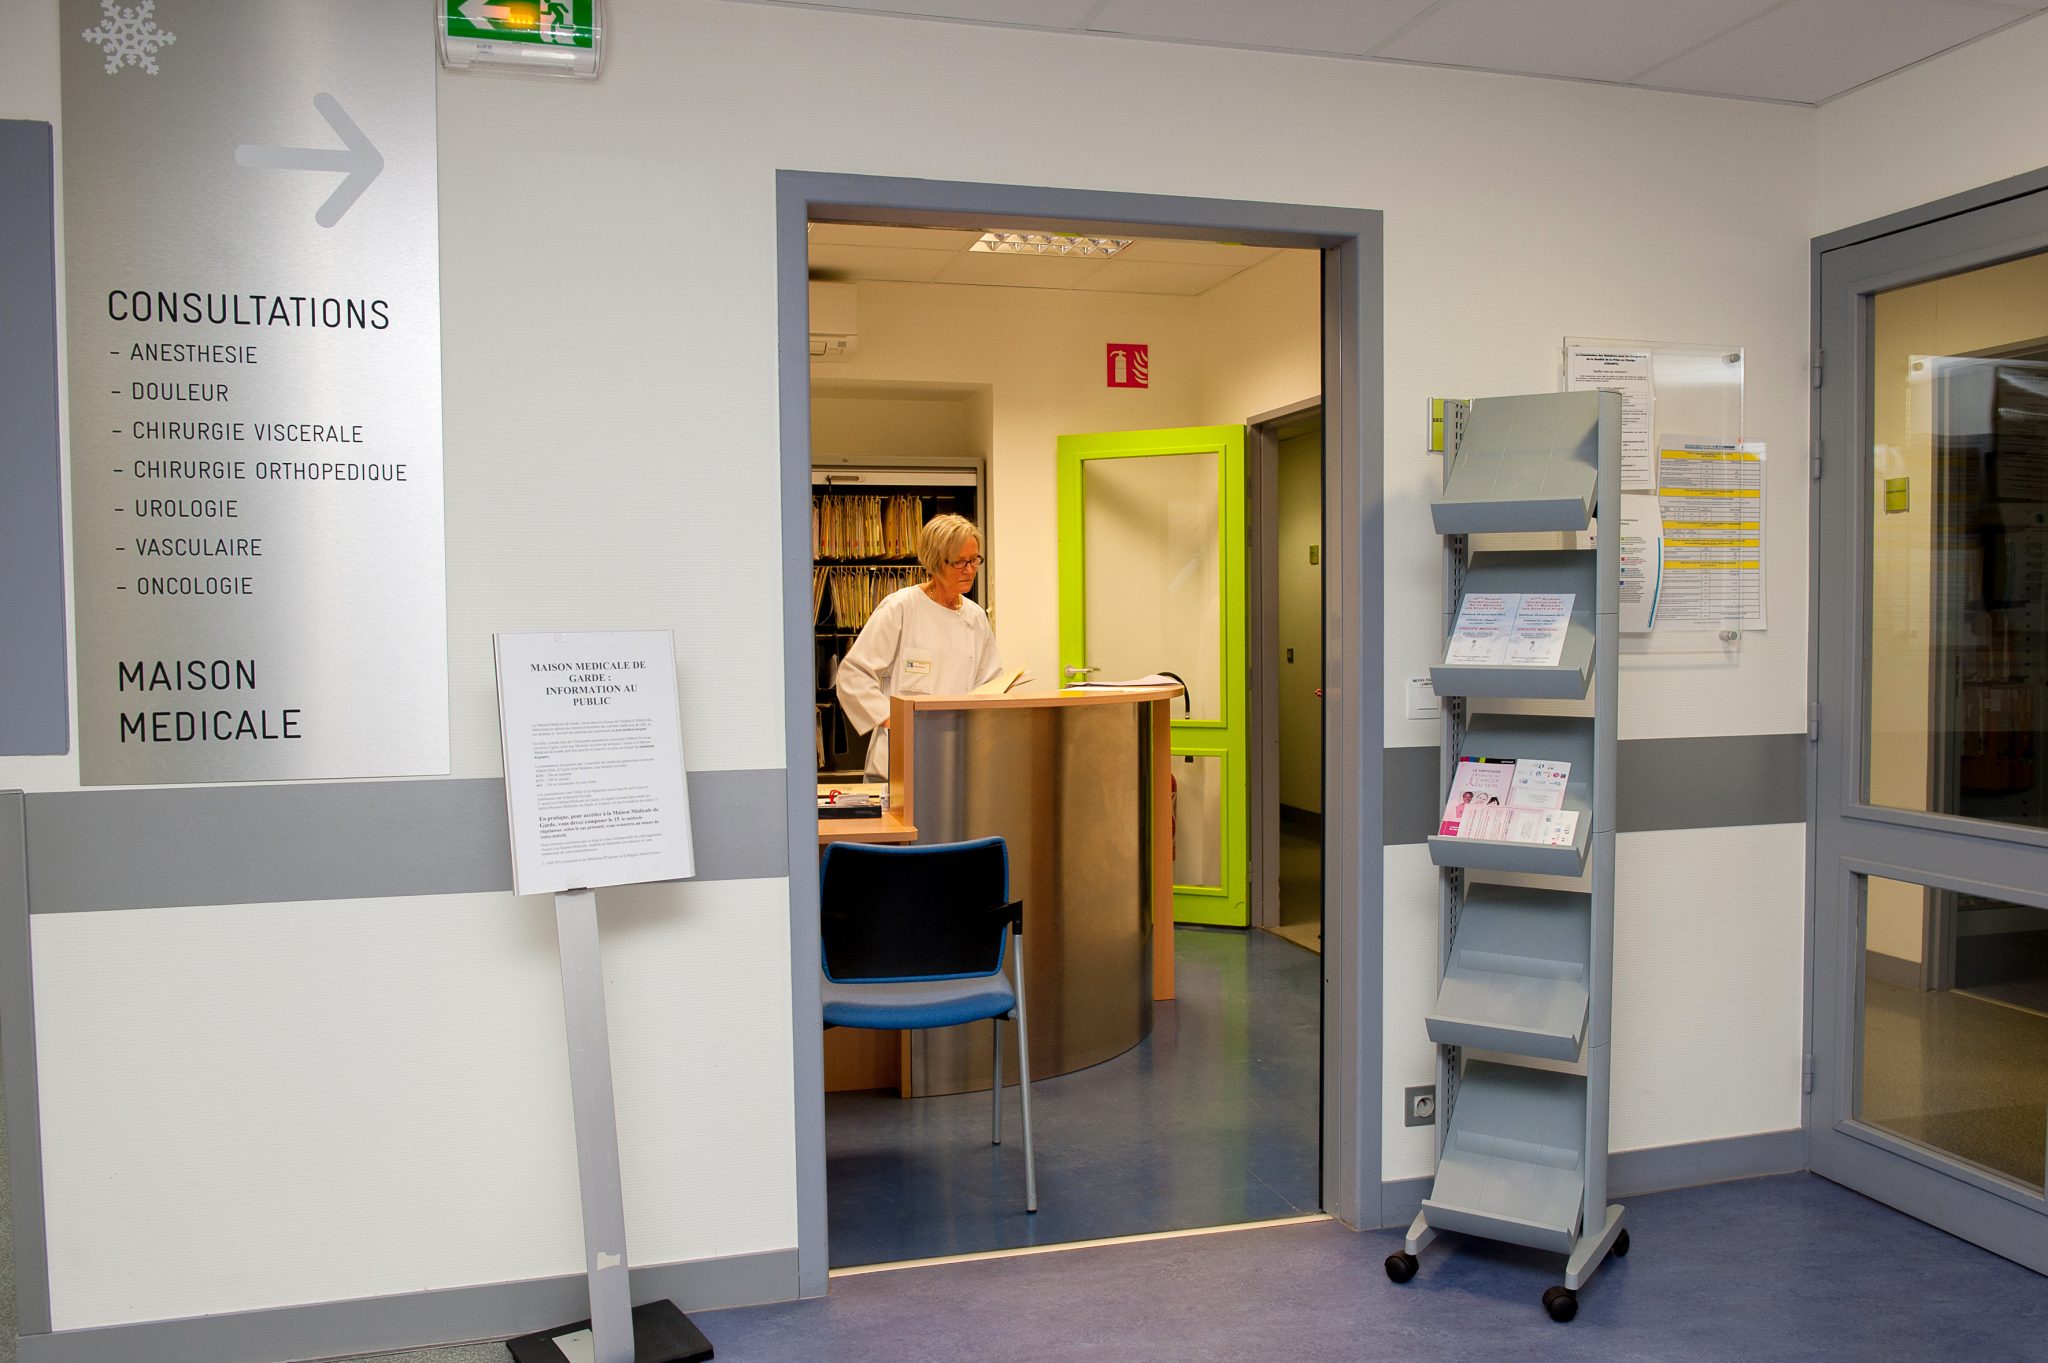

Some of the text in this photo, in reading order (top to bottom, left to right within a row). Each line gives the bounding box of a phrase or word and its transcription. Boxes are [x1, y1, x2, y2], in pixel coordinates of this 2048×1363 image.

[108, 289, 390, 330] CONSULTATIONS
[130, 342, 258, 365] ANESTHESIE
[132, 382, 229, 403] DOULEUR
[132, 421, 245, 441] CHIRURGIE
[253, 424, 364, 443] VISCERALE
[134, 460, 246, 480] CHIRURGIE
[255, 462, 408, 482] ORTHOPEDIQUE
[135, 499, 239, 518] UROLOGIE
[135, 538, 263, 557] VASCULAIRE
[137, 576, 254, 596] ONCOLOGIE
[118, 659, 256, 692] MAISON
[530, 660, 647, 672] MAISON MEDICALE DE
[568, 673, 606, 683] GARDE
[545, 684, 638, 696] INFORMATION AU
[573, 697, 612, 707] PUBLIC
[119, 708, 302, 743] MEDICALE
